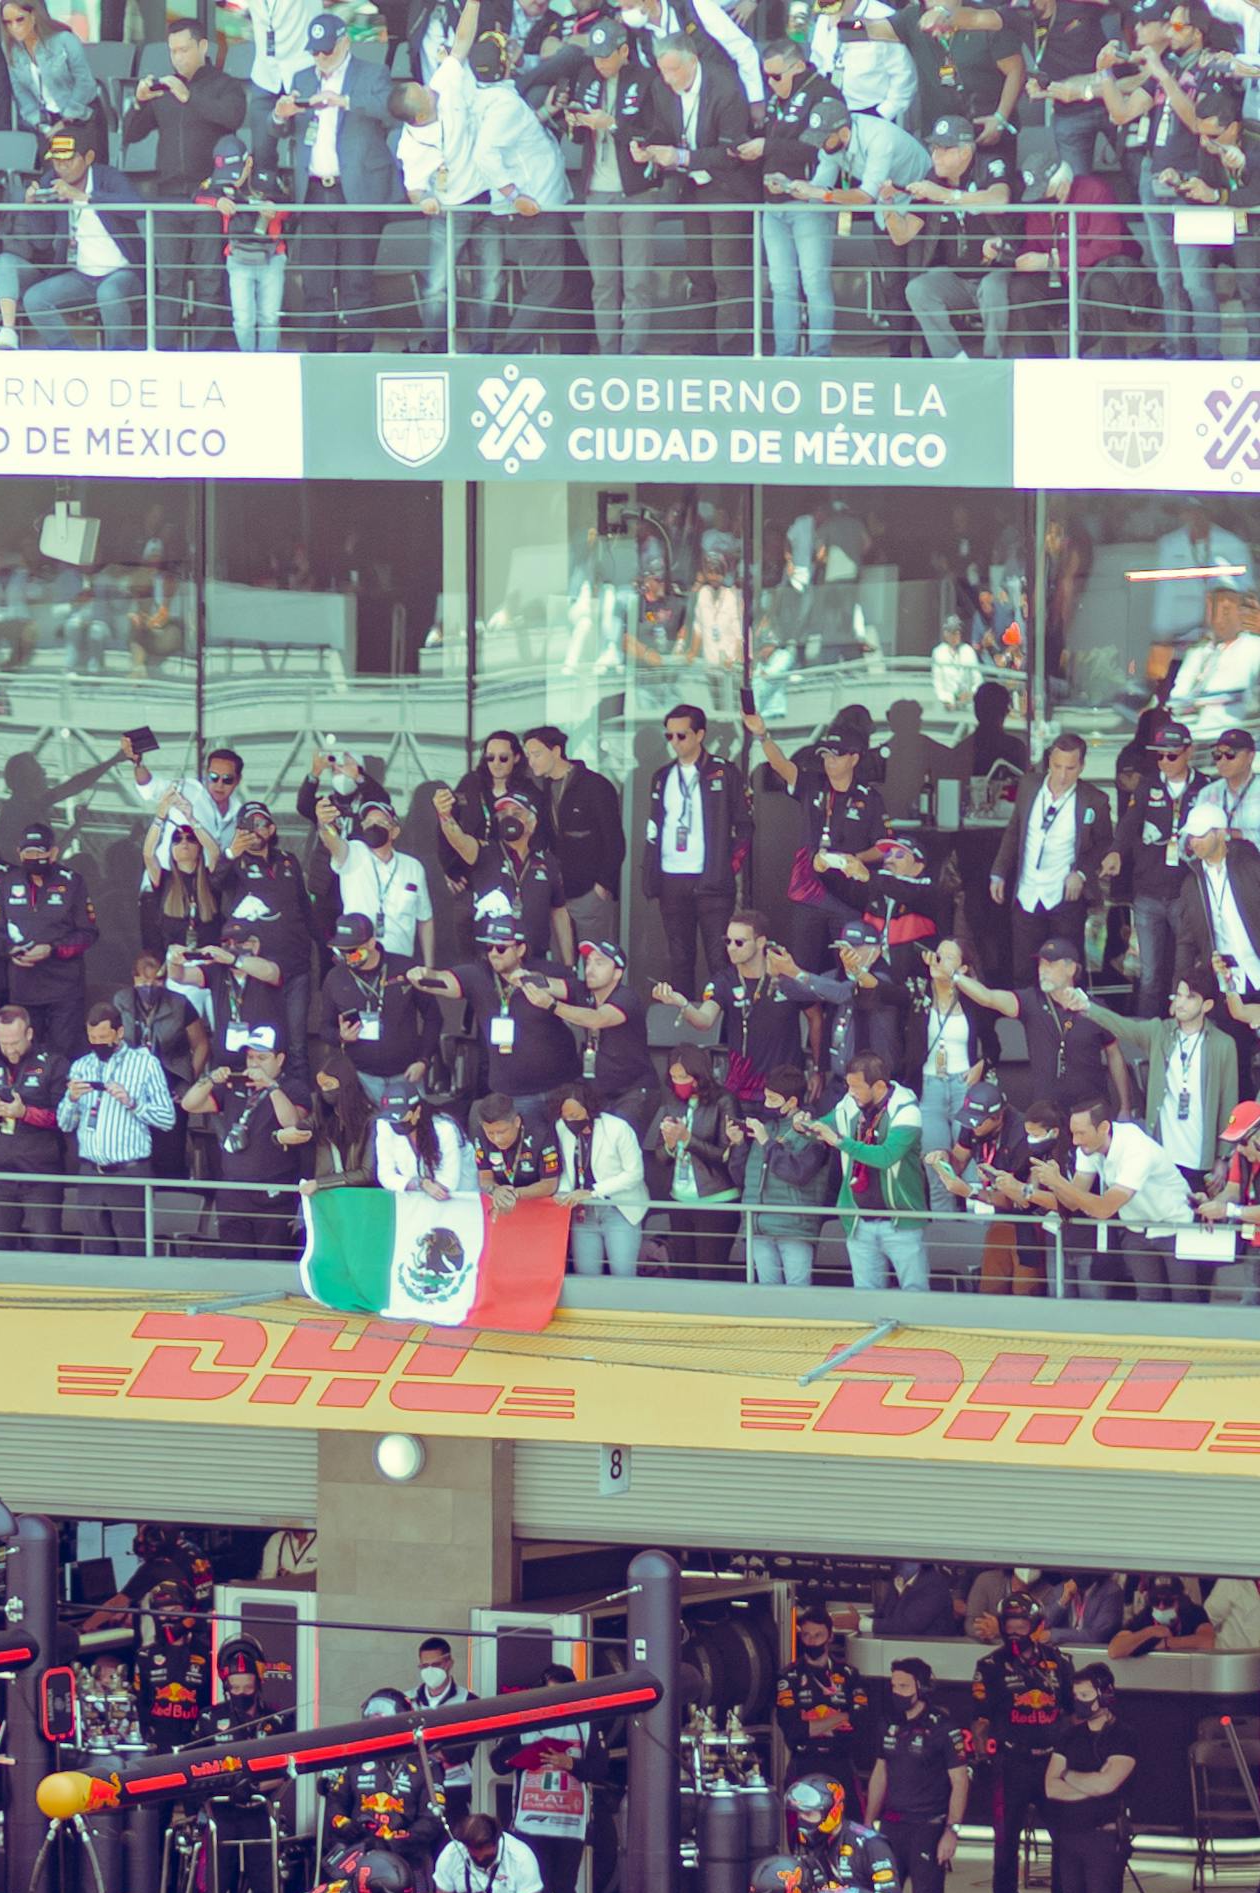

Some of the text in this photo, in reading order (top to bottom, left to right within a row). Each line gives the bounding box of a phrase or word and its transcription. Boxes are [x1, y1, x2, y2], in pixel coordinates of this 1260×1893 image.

[110, 378, 158, 409] DE
[179, 379, 227, 409] LA
[567, 377, 948, 418] GOBIERNO DE LA
[25, 426, 72, 455] DE
[86, 419, 227, 457] MÉXICO
[567, 422, 948, 469] CIUDAD DE MÉXICO
[125, 1311, 505, 1414] DHL
[812, 1343, 1216, 1452] DHL
[609, 1448, 623, 1480] 8
